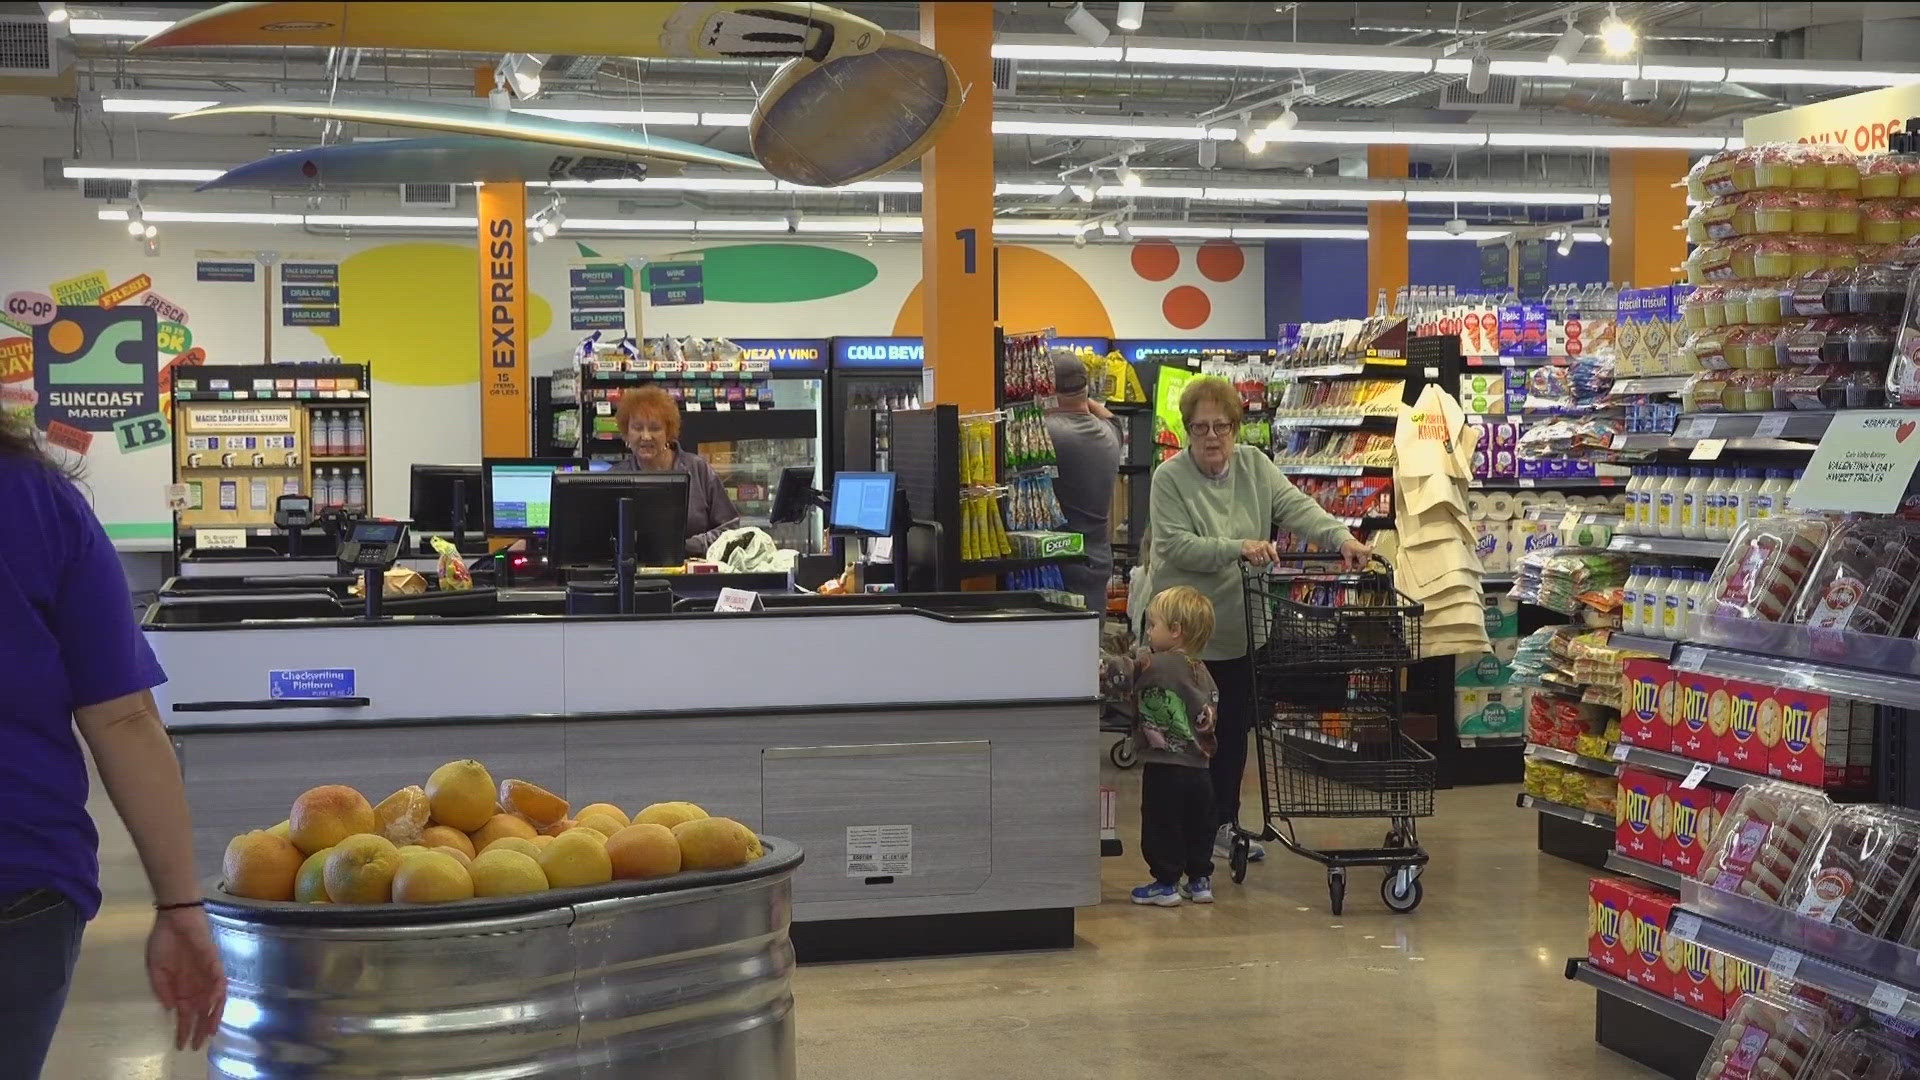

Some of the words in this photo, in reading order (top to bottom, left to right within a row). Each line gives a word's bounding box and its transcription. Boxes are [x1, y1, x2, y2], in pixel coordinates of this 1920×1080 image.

[955, 228, 977, 274] 1
[582, 271, 613, 280] PROTEIN
[666, 269, 686, 278] WINE
[56, 275, 102, 296] SILVER
[101, 275, 150, 308] FRESH
[290, 289, 310, 297] ORAL
[311, 289, 331, 297] CARE
[490, 218, 516, 369] EXPRESS
[667, 290, 687, 299] BEER
[59, 284, 106, 306] STRAND
[1642, 295, 1667, 309] triscuit
[9, 298, 52, 318] CO-OP
[144, 295, 185, 324] FRESCA
[292, 311, 310, 319] HAIR
[311, 311, 331, 319] CARE
[573, 315, 623, 323] SUPPLEMENTS
[158, 332, 186, 353] OK
[777, 348, 786, 360] Y
[788, 348, 818, 360] VINO
[847, 345, 887, 360] COLD
[497, 373, 509, 382] 15
[50, 391, 144, 408] SUNCOAST
[68, 408, 127, 418] MARKET
[260, 414, 288, 422] STATION
[119, 418, 167, 449] IB
[1875, 463, 1895, 472] DAY
[1826, 473, 1854, 482] SWEET
[1854, 474, 1884, 482] TREATS
[1046, 538, 1072, 552] Extra
[281, 671, 344, 681] Checkwriting
[293, 681, 333, 690] Platform
[1633, 678, 1659, 713] RITZ
[1683, 686, 1709, 723] RITZ
[1730, 694, 1758, 733] RITZ
[1782, 705, 1812, 744] RITZ
[1626, 788, 1651, 825] RITZ
[1673, 800, 1698, 839] RITZ
[1598, 901, 1620, 940] RITZ
[1636, 917, 1661, 957] RITZ
[1684, 940, 1709, 976] RITZ
